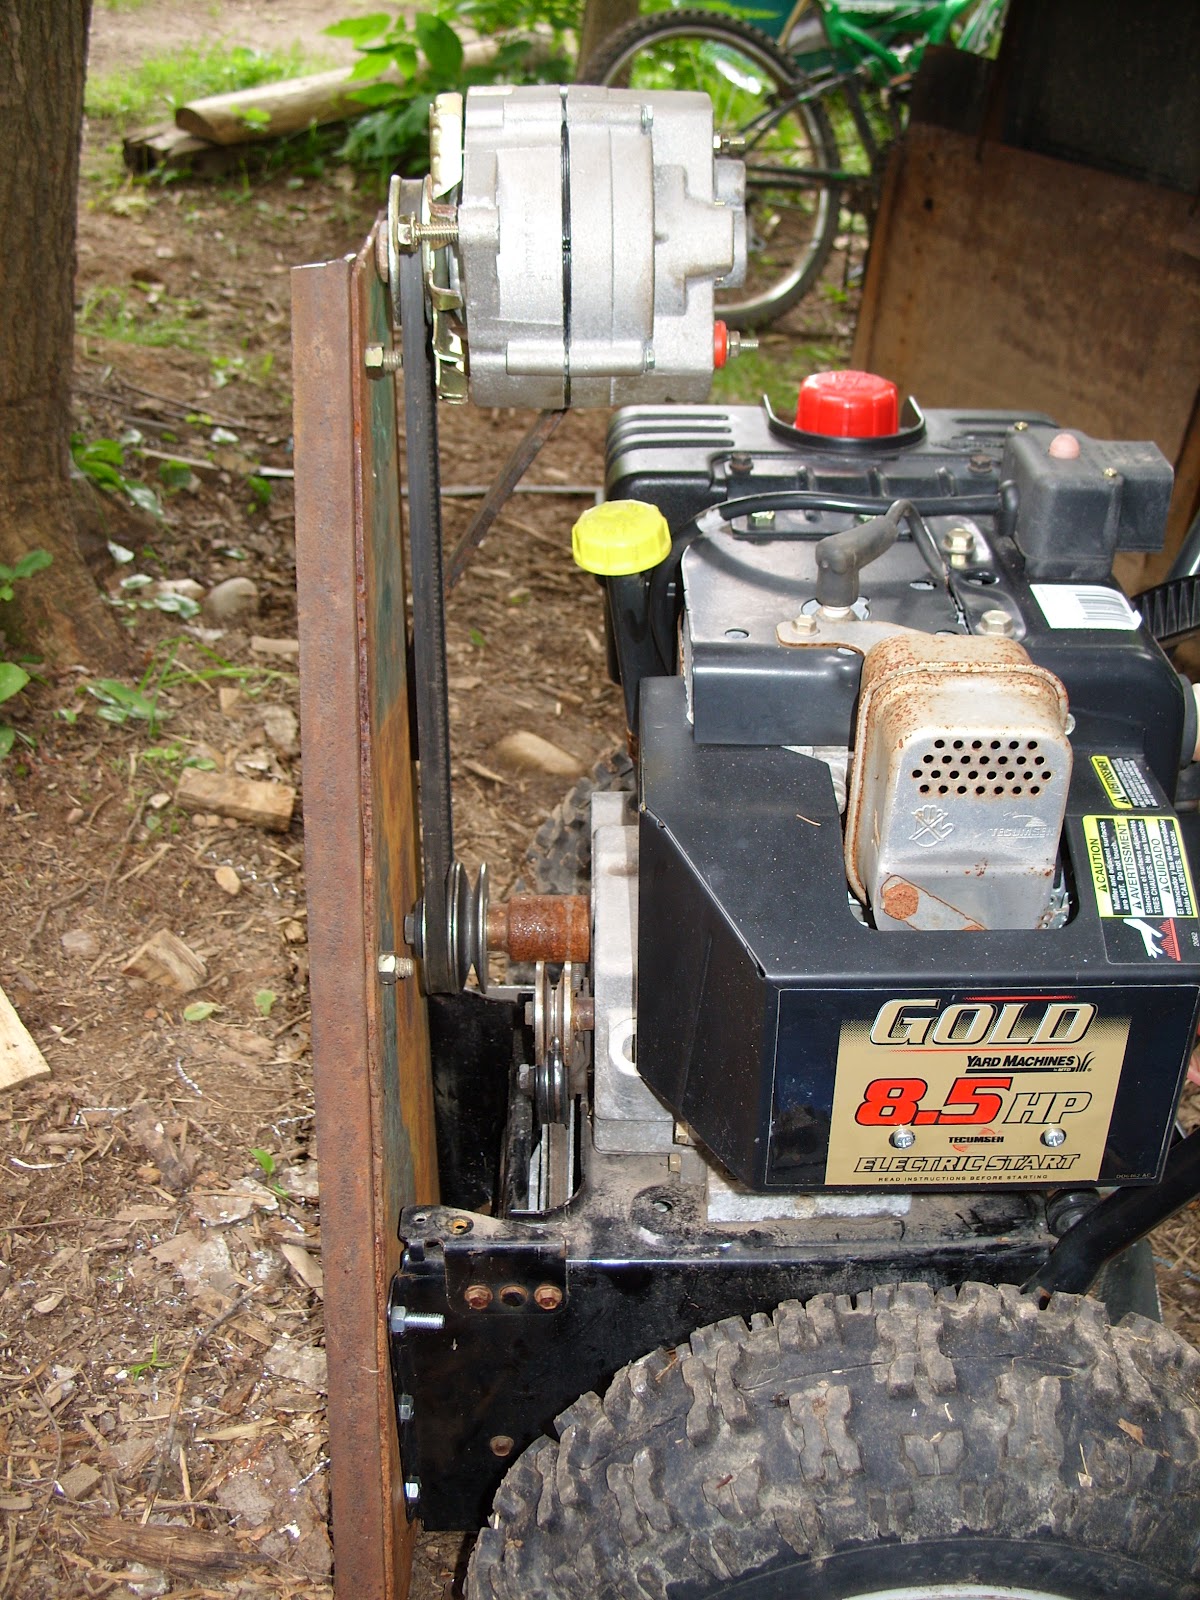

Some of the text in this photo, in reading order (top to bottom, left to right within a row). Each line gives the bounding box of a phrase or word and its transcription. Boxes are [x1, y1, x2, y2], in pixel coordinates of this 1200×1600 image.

[1099, 821, 1109, 846] surfaces
[1129, 820, 1143, 850] adjacentes
[1138, 820, 1148, 842] toucher.
[1160, 820, 1170, 845] alrededor
[1089, 838, 1105, 883] CAUTION
[1103, 848, 1115, 874] adjacent
[1112, 841, 1120, 859] touch.
[1117, 822, 1140, 899] AVERTISSMENT
[1144, 844, 1152, 854] pas
[1151, 838, 1168, 884] CUIDADO
[1135, 851, 1146, 875] surfaces
[1170, 830, 1192, 914] están CALIENTES. No tocar.
[1116, 872, 1123, 880] Do
[1147, 864, 1158, 895] CHAUDES.
[1110, 888, 1120, 910] Muffler
[1119, 883, 1127, 898] HOT.
[1142, 884, 1153, 913] Silencieux
[1171, 877, 1183, 907] silenciador
[869, 999, 1099, 1045] GOLD
[967, 1055, 1075, 1067] YARD MACHINES
[855, 1077, 1093, 1126] 8.5 HP
[854, 1154, 1080, 1172] ELECTRIC START
